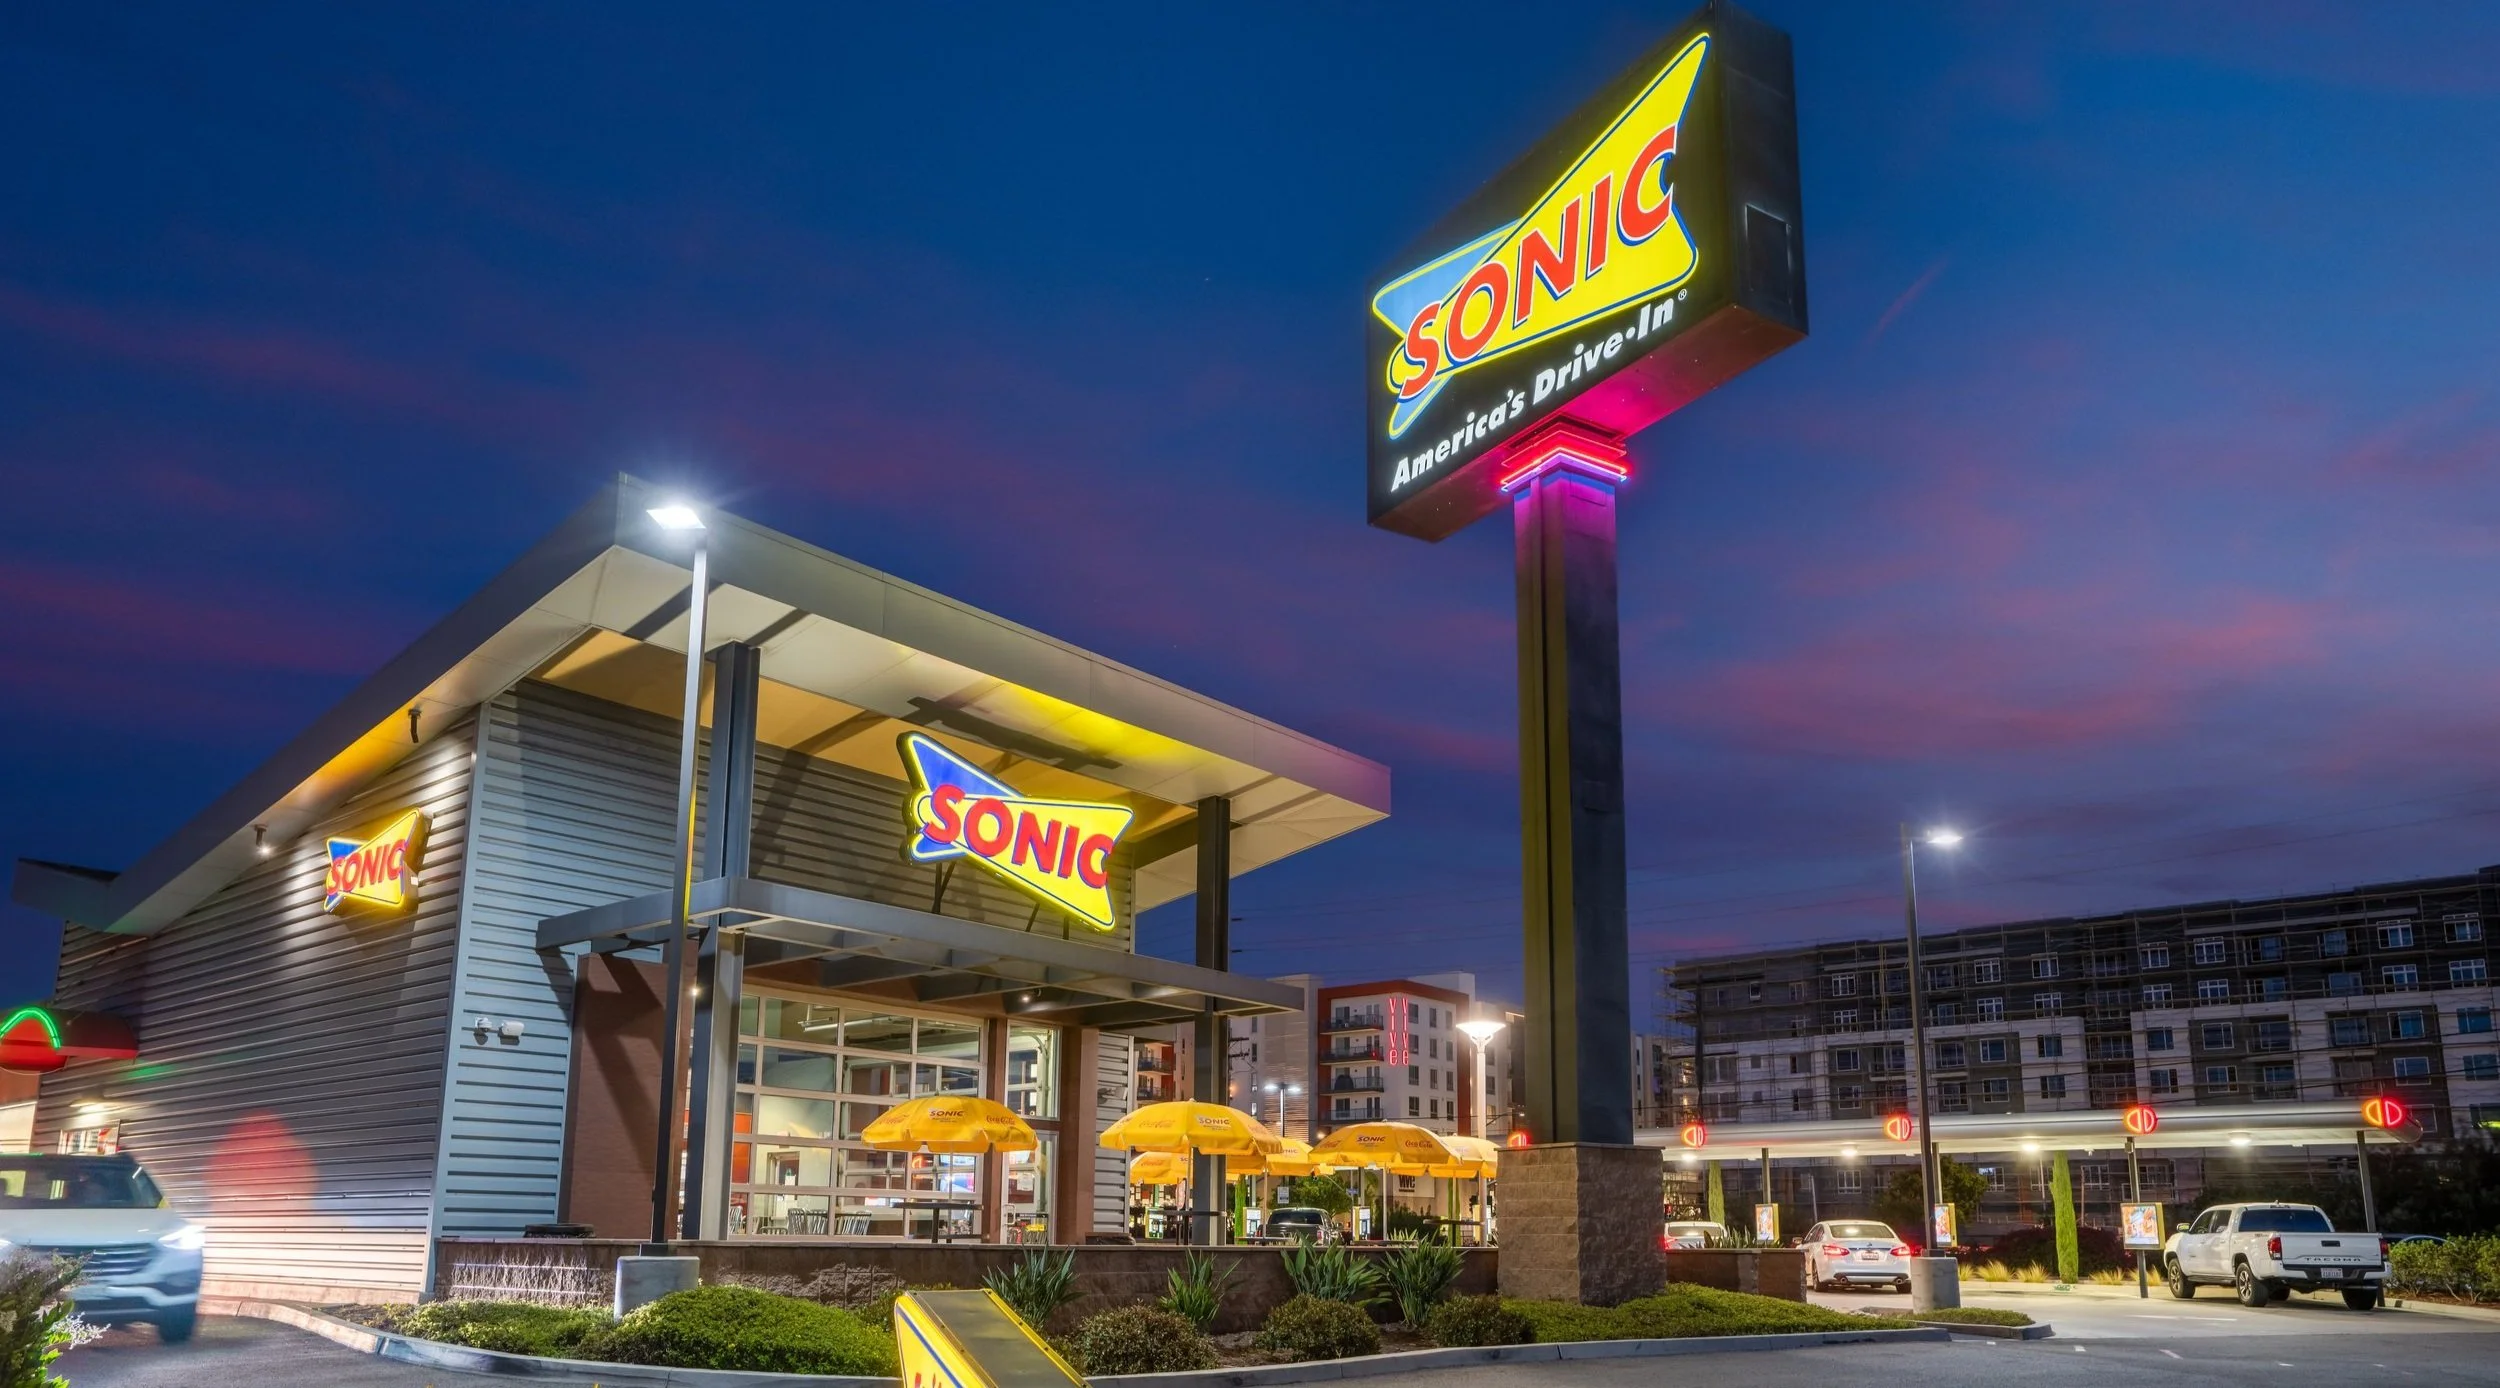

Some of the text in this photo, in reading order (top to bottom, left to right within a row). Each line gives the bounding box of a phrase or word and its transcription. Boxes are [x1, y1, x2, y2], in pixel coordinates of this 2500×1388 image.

[1398, 123, 1679, 402] SONIC
[1391, 389, 1526, 493] America's
[326, 838, 407, 896] SONIC
[921, 783, 1115, 889] SONIC
[1198, 1117, 1231, 1125] SONIC
[1356, 1135, 1386, 1143] SONIC
